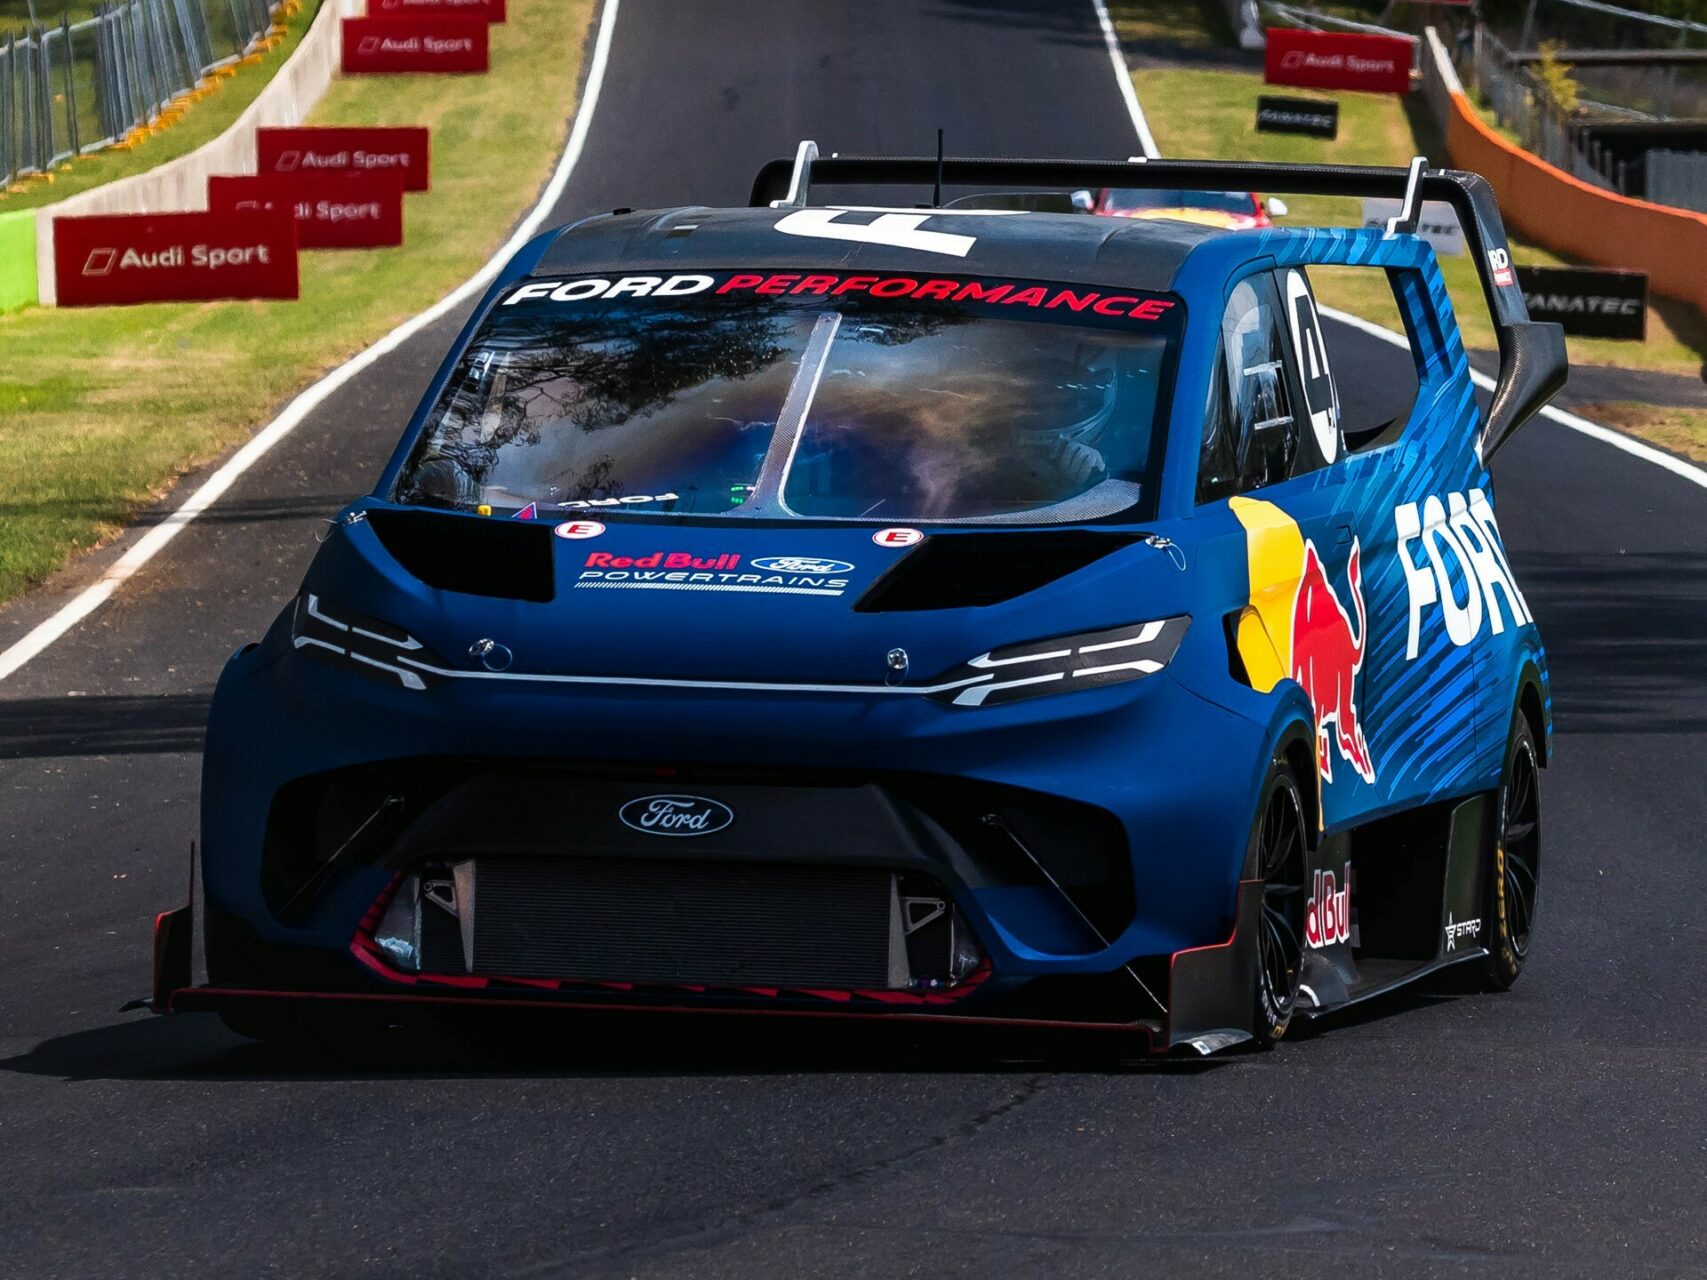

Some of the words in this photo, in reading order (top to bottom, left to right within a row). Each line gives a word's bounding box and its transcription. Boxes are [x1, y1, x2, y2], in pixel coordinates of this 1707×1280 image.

[380, 37, 419, 52] Audi
[423, 36, 473, 54] Sport
[1305, 52, 1343, 68] Audi
[301, 150, 347, 168] Audi
[353, 150, 410, 169] Sport
[316, 200, 381, 222] Sport
[120, 245, 185, 268] Audi
[191, 243, 269, 269] Sport
[502, 274, 715, 305] FORD
[715, 274, 1176, 320] PERFORMANCE
[567, 524, 592, 535] E
[885, 532, 911, 543] E
[584, 552, 665, 569] Red
[664, 552, 740, 571] Bull
[769, 558, 836, 573] Ford
[578, 570, 850, 589] POWERTRAINS
[640, 799, 712, 829] Ford
